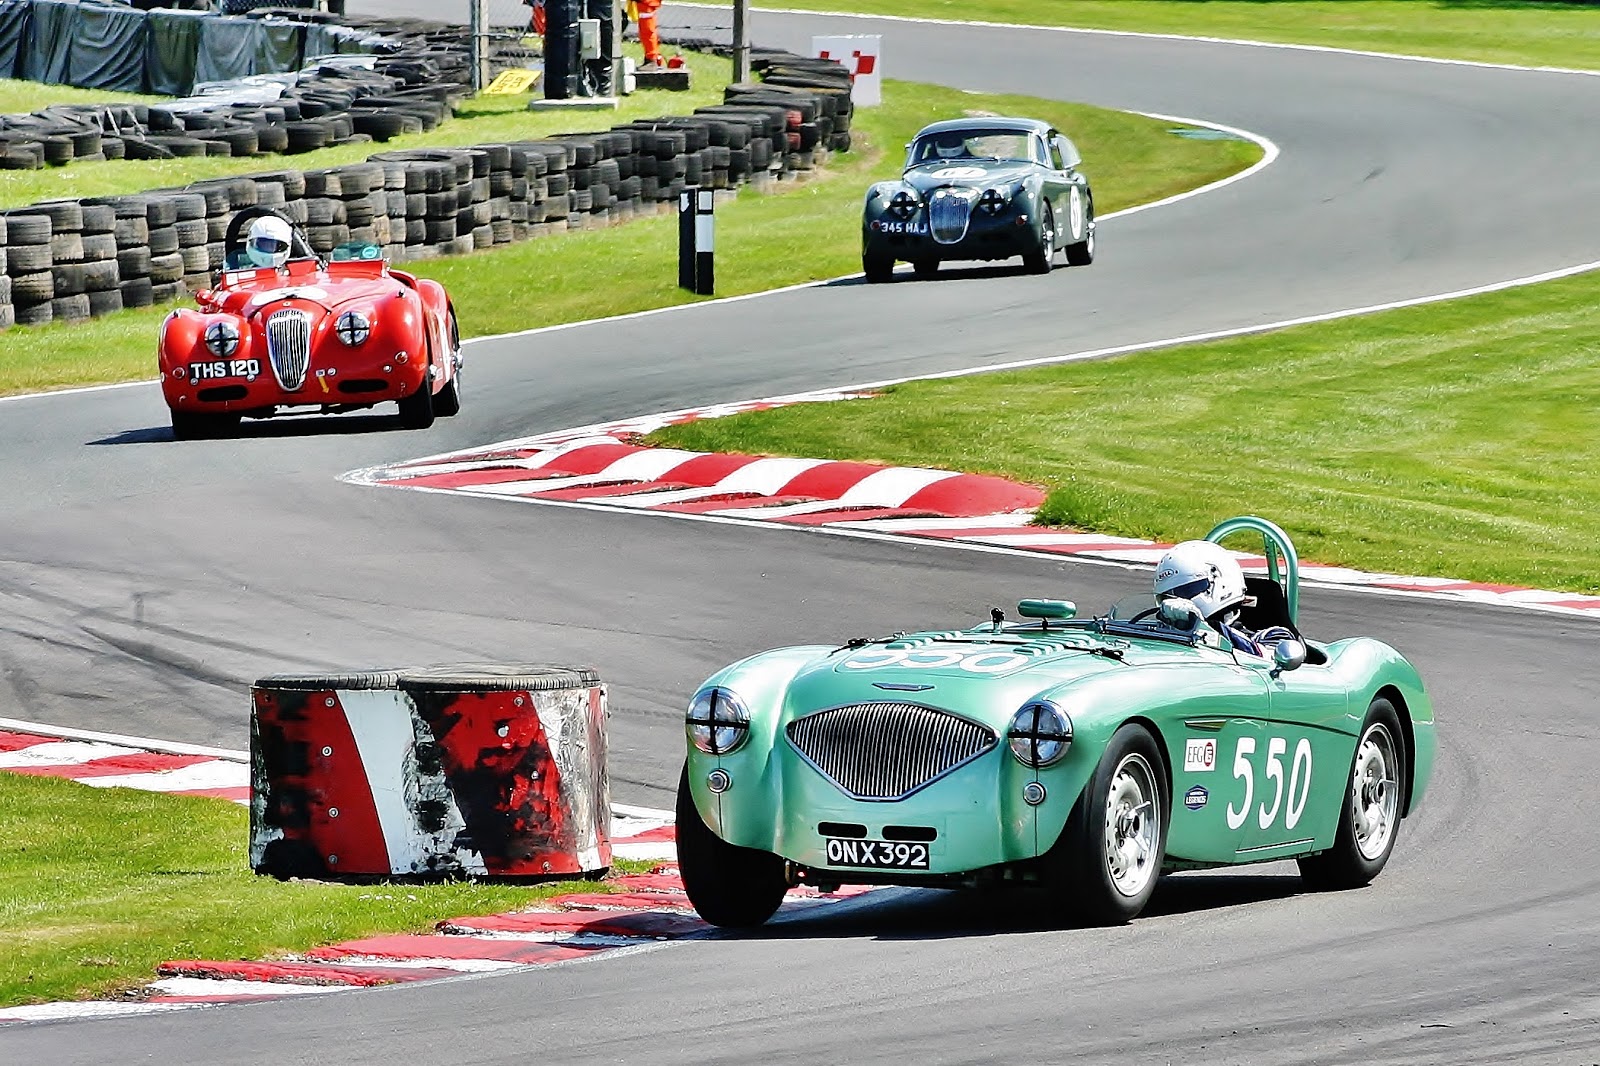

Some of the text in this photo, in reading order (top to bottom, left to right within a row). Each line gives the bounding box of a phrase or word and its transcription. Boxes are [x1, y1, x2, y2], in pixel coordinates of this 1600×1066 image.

[881, 222, 902, 233] 345
[190, 359, 259, 379] THS 120
[1226, 736, 1313, 830] 550
